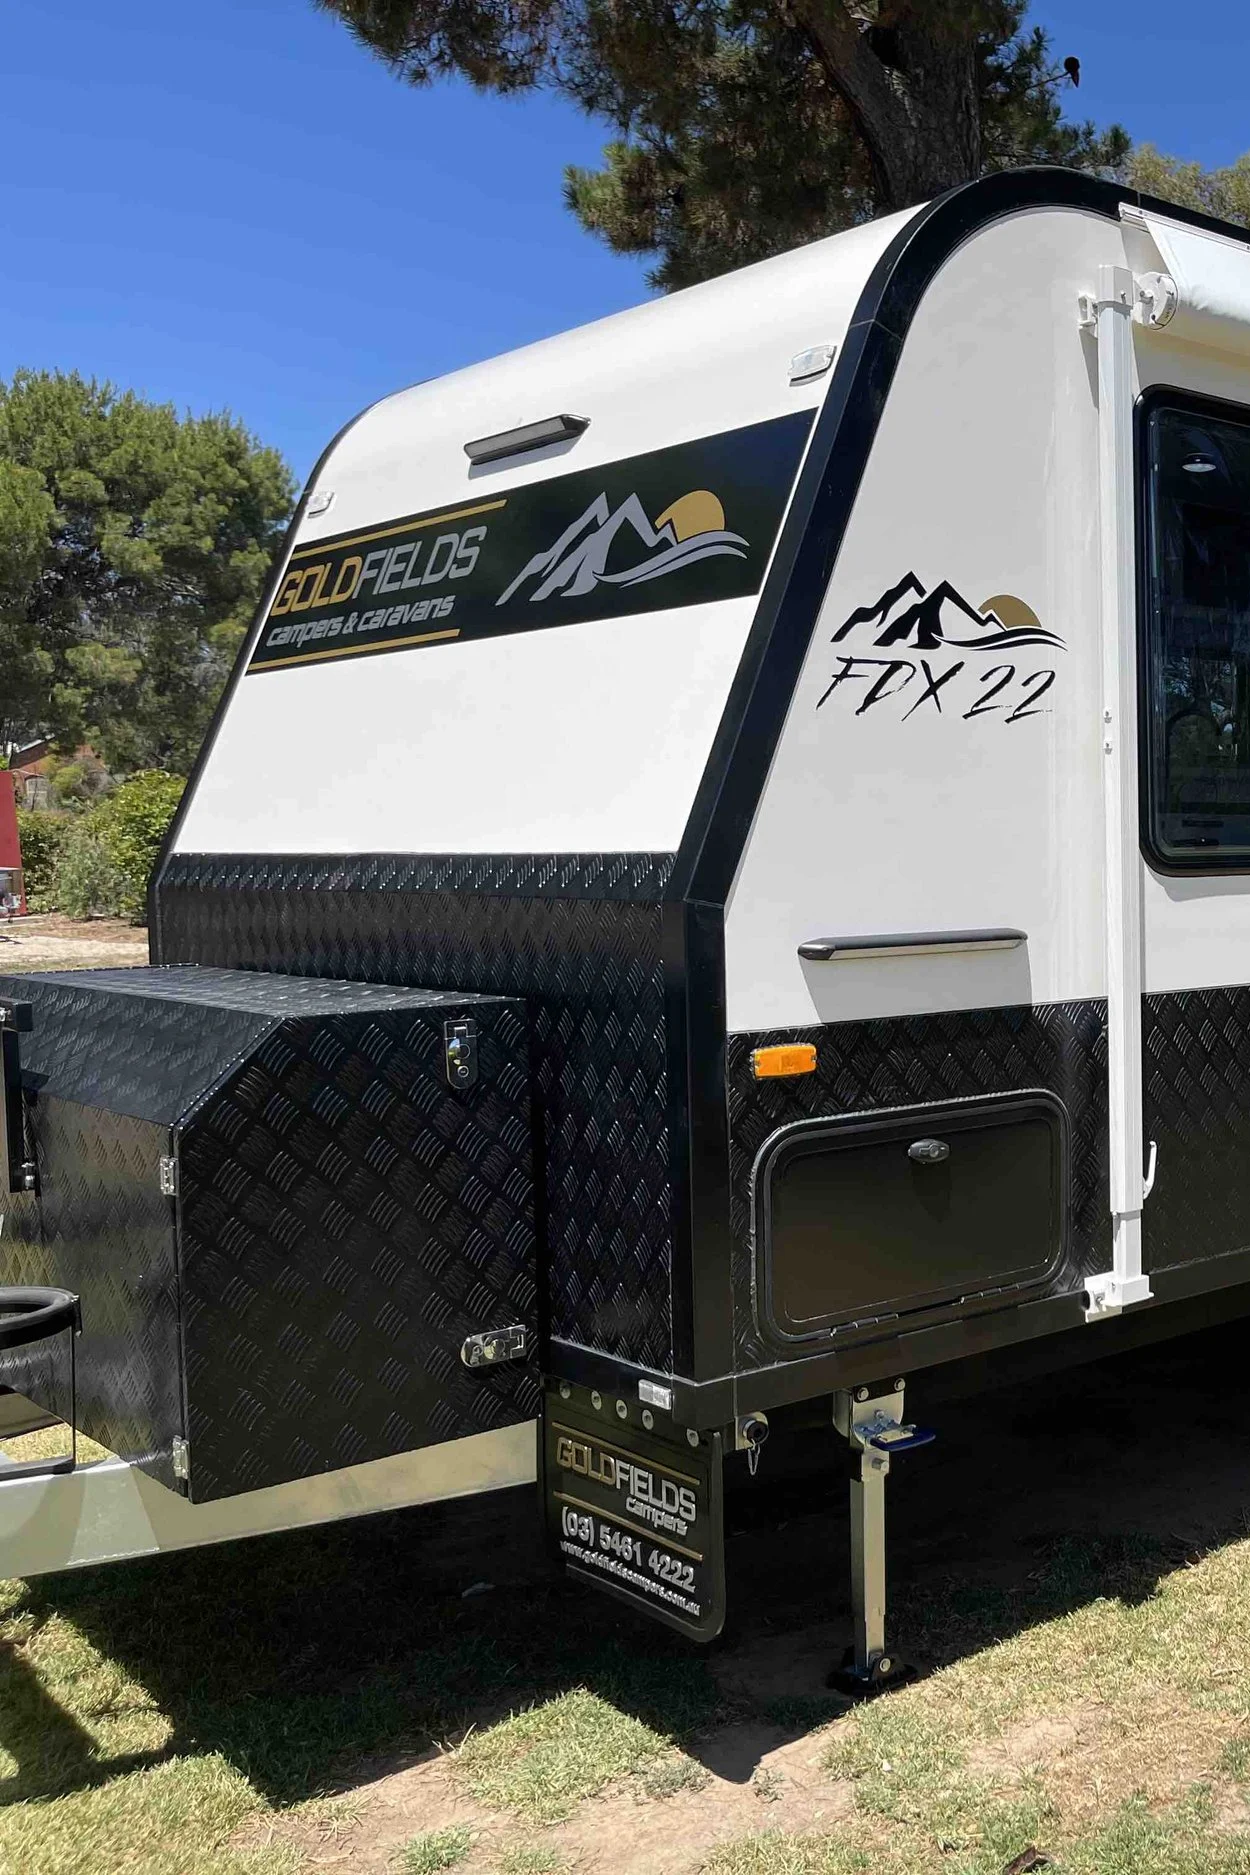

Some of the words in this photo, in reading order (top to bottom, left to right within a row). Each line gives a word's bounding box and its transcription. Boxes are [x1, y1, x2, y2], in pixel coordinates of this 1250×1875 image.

[270, 525, 488, 617] GOLDFIELDS
[266, 615, 343, 648] campers
[341, 611, 358, 634] &
[357, 595, 456, 632] caravans
[816, 655, 965, 722] FDX
[962, 664, 1056, 724] 22
[556, 1436, 697, 1522] GOLDFIELDS
[625, 1496, 688, 1536] campers
[561, 1506, 595, 1547] (03)
[599, 1524, 642, 1566] 5461
[648, 1550, 697, 1593] 4222
